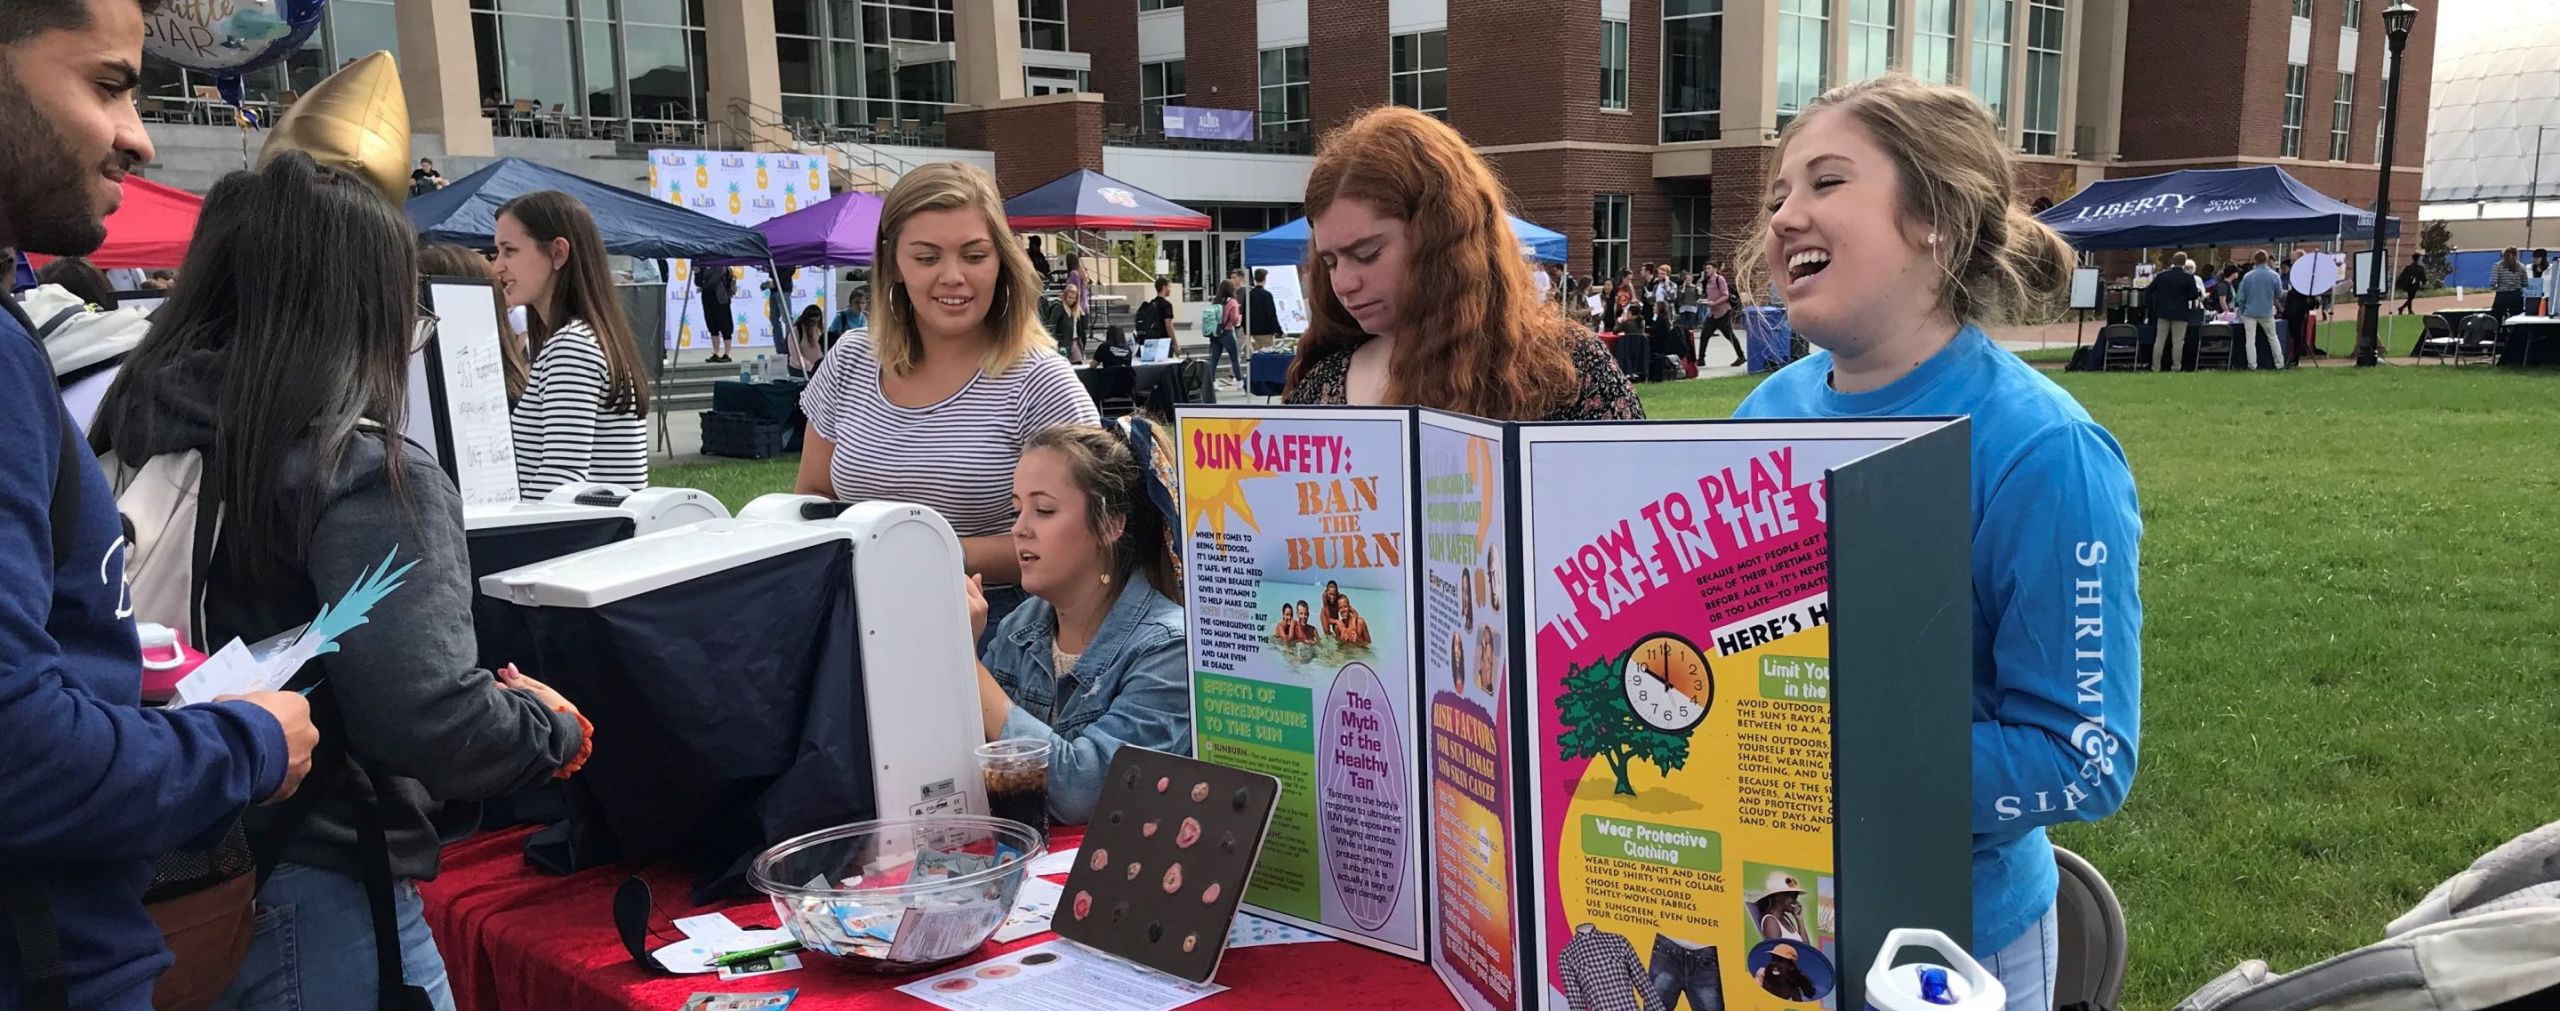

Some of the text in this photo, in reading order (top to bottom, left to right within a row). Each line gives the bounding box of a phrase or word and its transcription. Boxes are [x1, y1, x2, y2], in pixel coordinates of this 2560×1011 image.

[2076, 193, 2196, 219] LIBERTY
[2209, 197, 2258, 206] SCHOOL
[1193, 428, 1352, 474] SUN SAFETY:
[1295, 476, 1378, 515] BAN
[1319, 515, 1361, 534] THE
[1554, 519, 1637, 597] HOW
[1640, 492, 1692, 545] TO
[1698, 446, 1792, 518] PLAY
[1196, 531, 1214, 539] WHEN
[1216, 532, 1221, 540] IT
[1224, 533, 1242, 541] COMES
[1197, 542, 1214, 550] BEING
[1286, 532, 1400, 570] BURN
[1696, 534, 1820, 585] BECAUSE MOST PEOPLE GET
[1222, 566, 1231, 574] WE
[1233, 567, 1244, 575] ALL
[1550, 600, 1589, 649] IT
[1588, 554, 1669, 621] SAFE
[1666, 518, 1719, 574] IN
[1719, 491, 1800, 549] THE
[1725, 552, 1812, 589] OF THEIR LIFETIME
[1705, 592, 1739, 610] BEFORE
[1744, 584, 1761, 597] AGE
[1781, 571, 1796, 584] IT'S
[1709, 605, 1745, 623] OR TOO
[1717, 613, 1801, 656] HERE'S
[1647, 649, 1656, 660] 11
[1660, 644, 1671, 656] 12
[1636, 662, 1649, 673] 10
[1689, 664, 1697, 675] 2
[1763, 658, 1800, 679] Limit
[1633, 675, 1641, 686] 9
[1694, 680, 1702, 691] 3
[1784, 680, 1827, 699] in the
[1203, 678, 1275, 703] EFFECTS OF
[1639, 691, 1647, 701] 8
[1346, 691, 1372, 710] The
[1651, 703, 1659, 714] 7
[1690, 695, 1698, 705] 4
[1737, 699, 1823, 714] AVOID OUTDOOR
[1204, 697, 1307, 728] OVEREXPOSURE
[1664, 710, 1672, 721] 6
[1680, 706, 1688, 717] 5
[1737, 709, 1815, 723] THE SUN'S RAYS
[1204, 716, 1282, 743] TO THE SUN
[1342, 711, 1378, 733] Myth
[1434, 703, 1496, 756] RISK FACTORS
[1738, 719, 1781, 730] BETWEEN
[1801, 725, 1823, 734] A.M.
[1340, 732, 1381, 751] of the
[1737, 733, 1767, 742] WHEN
[1436, 733, 1495, 780] FOR SUN DAMAGE
[1738, 742, 1801, 756] YOURSELF BY
[1335, 749, 1388, 777] Healthy
[1777, 757, 1823, 769] WEARING
[1349, 771, 1374, 790] Tan
[1438, 757, 1495, 802] AND SKIN CANCER
[1795, 769, 1817, 778] AND
[1738, 776, 1819, 792] BECAUSE OF THE
[1739, 797, 1823, 813] AND PROTECTIVE
[1784, 792, 1823, 803] ALWAYS
[1739, 807, 1833, 824] CLOUDY DAYS AND
[1772, 820, 1786, 829] OR
[1596, 817, 1707, 848] Wear Protective
[1624, 840, 1678, 864] Clothing
[1584, 855, 1726, 883] WEAR LONG PANTS AND LONG-
[1585, 865, 1681, 886] SLEEVED SHIRTS WITH
[1585, 878, 1619, 889] CHOOSE
[1585, 886, 1696, 911] TIGHTLY-WOVEN FABRICS
[1586, 899, 1719, 928] USE EVEN UNDER
[1586, 908, 1610, 919] YOUR
